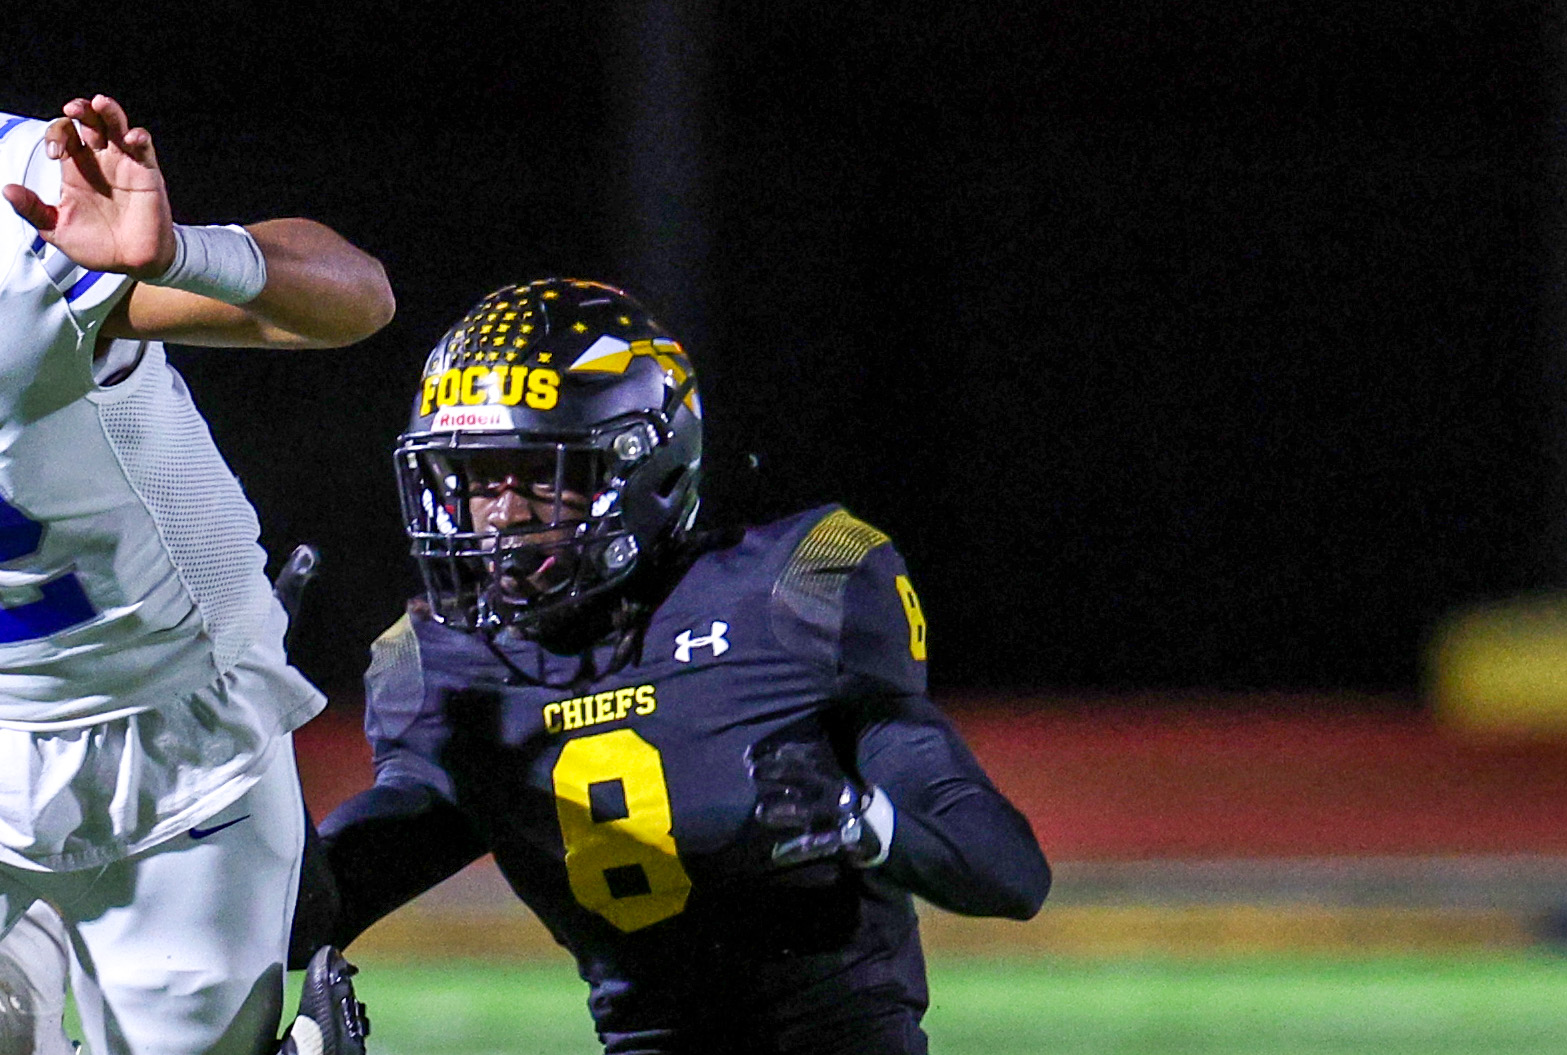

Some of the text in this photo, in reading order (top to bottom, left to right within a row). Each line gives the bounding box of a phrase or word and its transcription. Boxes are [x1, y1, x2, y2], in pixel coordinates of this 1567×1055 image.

[419, 364, 561, 418] FOCUS
[894, 574, 928, 661] 8
[542, 684, 658, 735] CHIEFS
[552, 728, 693, 934] 8
